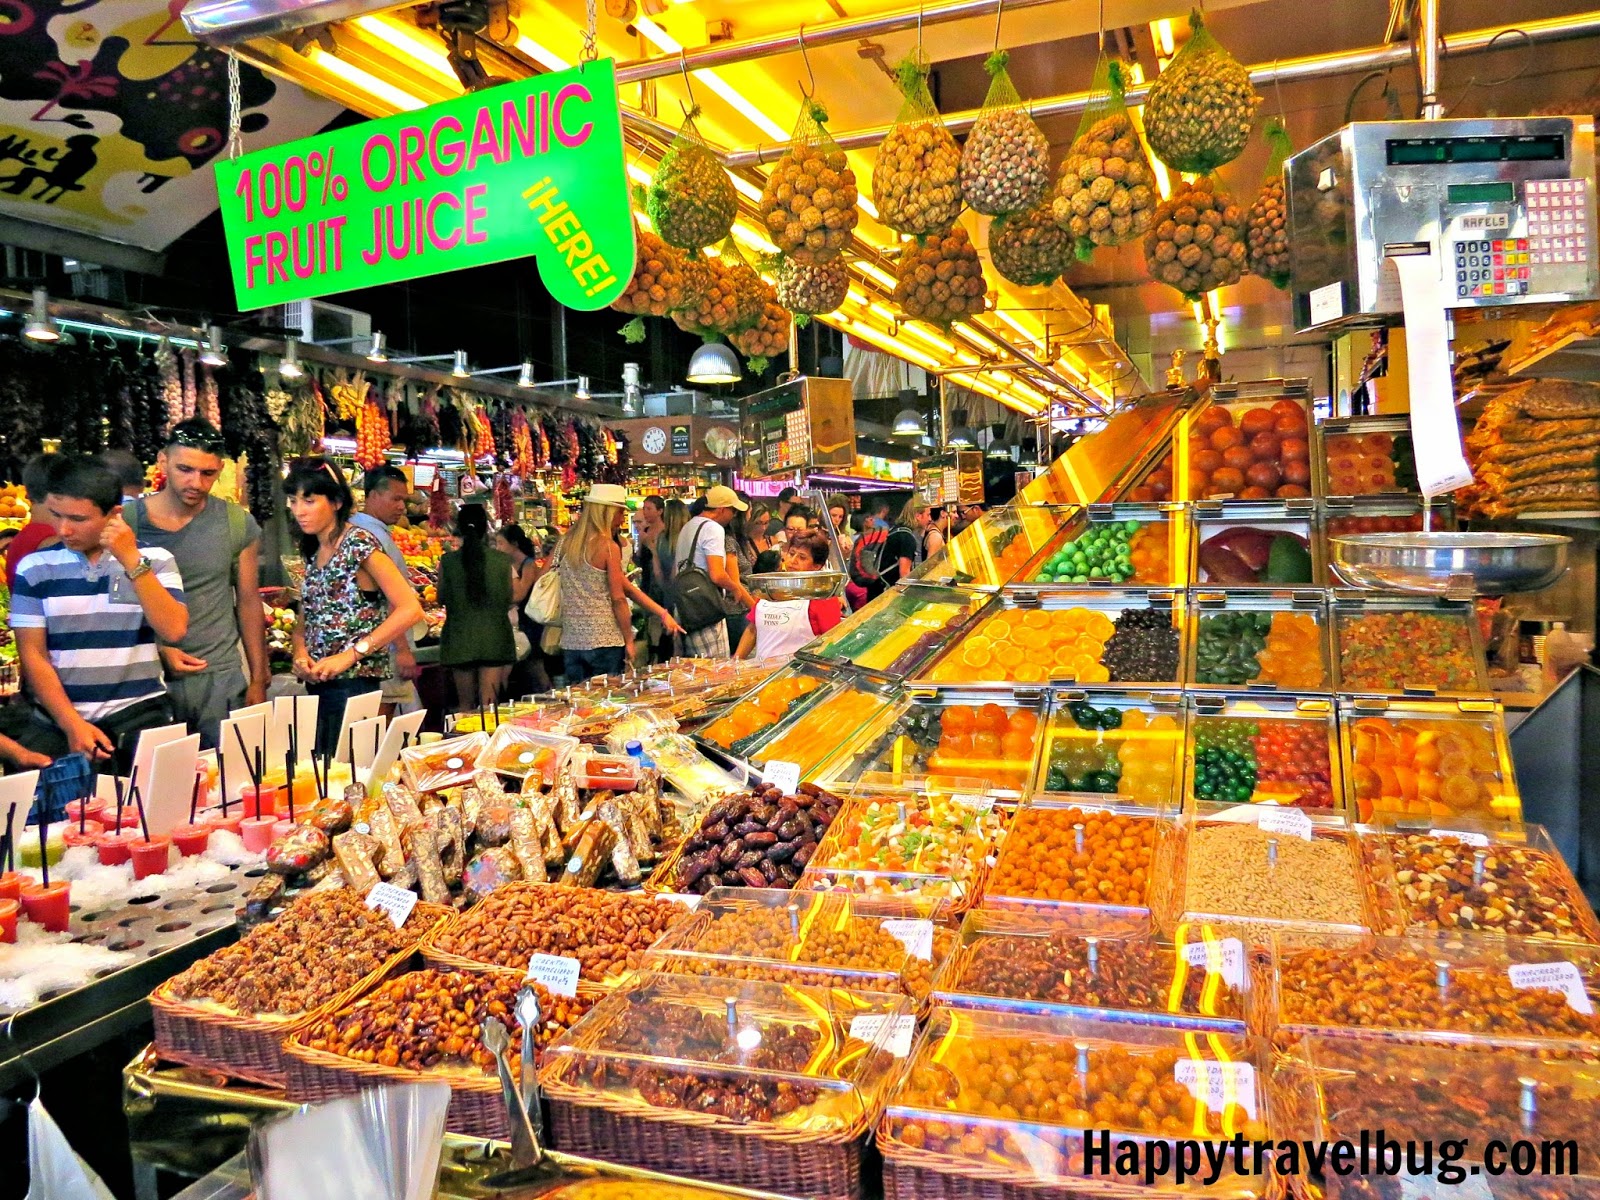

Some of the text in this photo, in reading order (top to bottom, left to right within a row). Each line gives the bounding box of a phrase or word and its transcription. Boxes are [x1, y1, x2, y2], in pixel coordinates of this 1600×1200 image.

[235, 83, 594, 223] 100% ORGANIC
[244, 184, 488, 290] FRUIT JUICE
